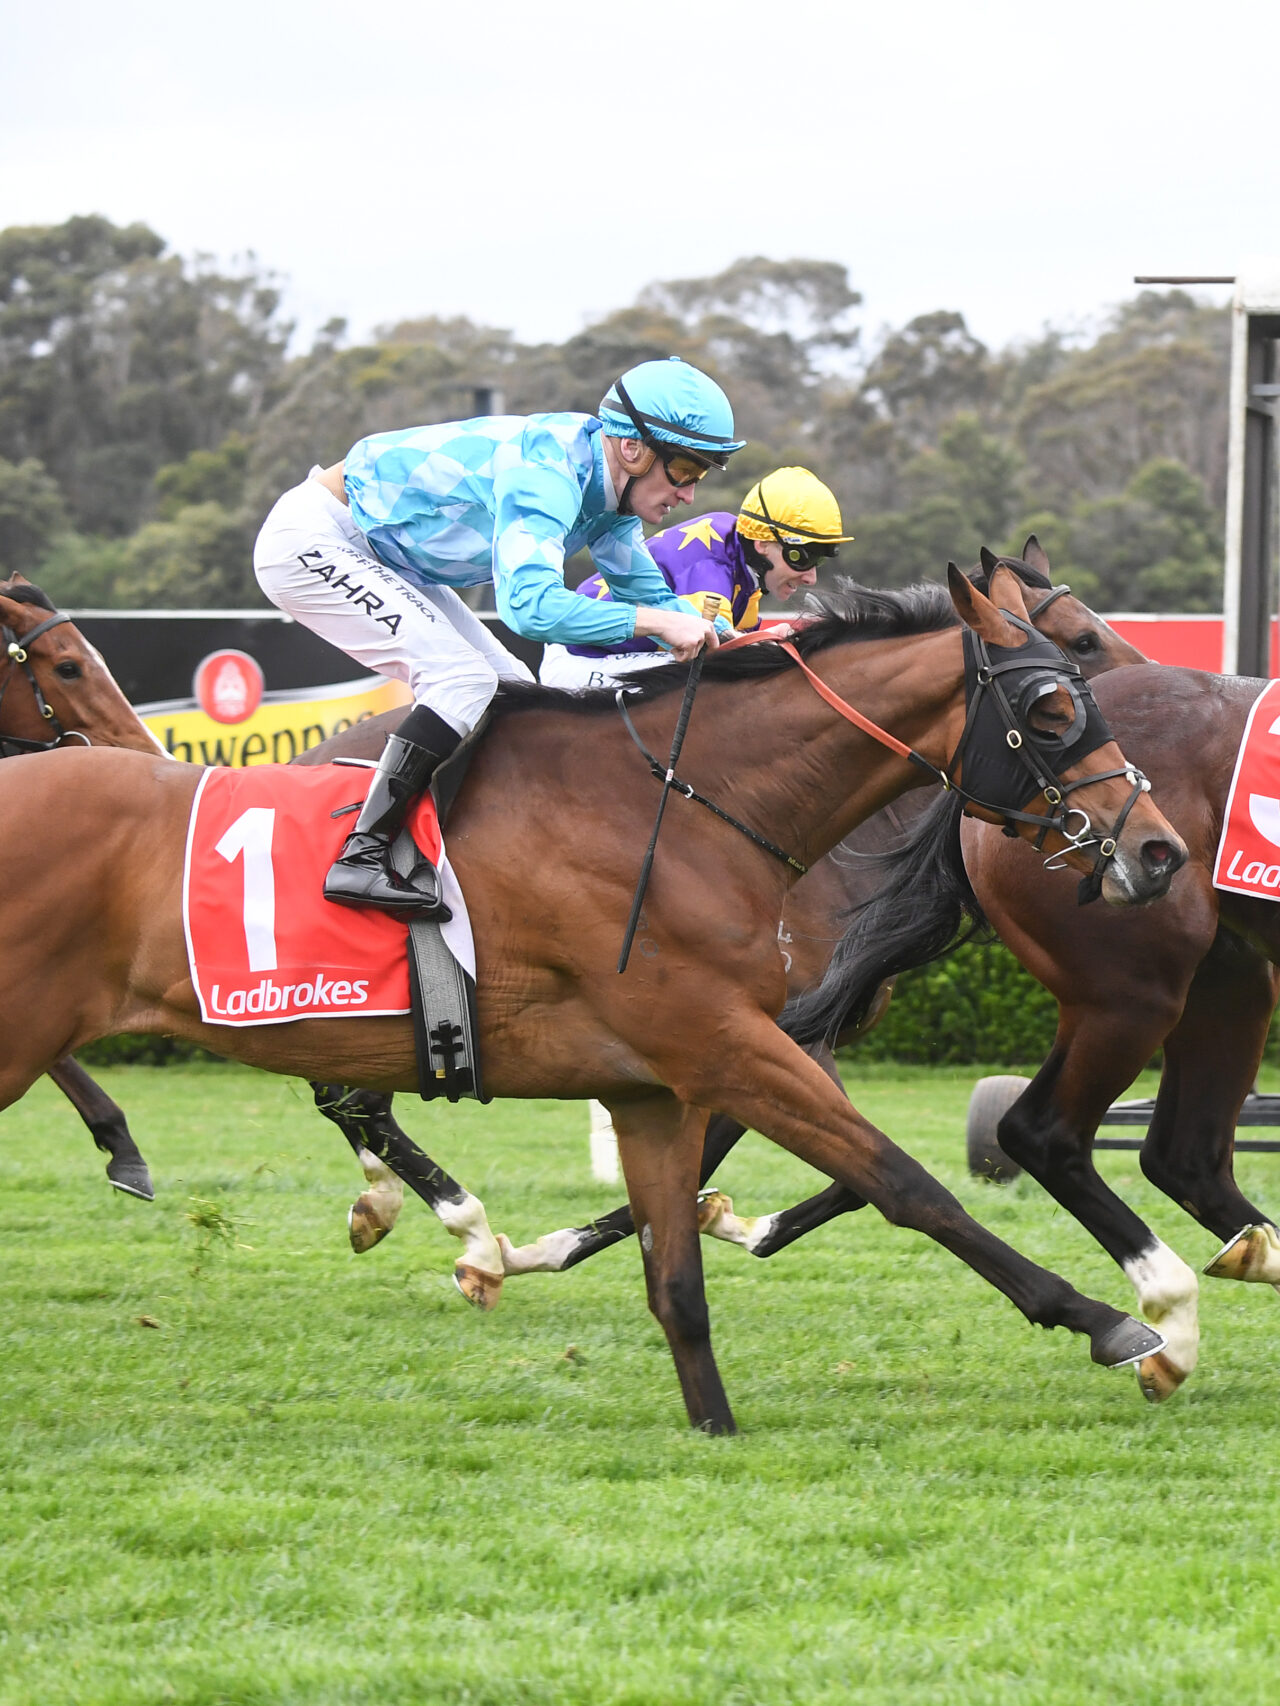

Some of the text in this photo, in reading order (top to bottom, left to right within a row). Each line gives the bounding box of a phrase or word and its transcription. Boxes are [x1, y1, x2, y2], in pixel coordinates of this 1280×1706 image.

[297, 550, 402, 635] ZAHRA
[215, 807, 277, 972] 1
[211, 974, 368, 1015] Ladbrokes
